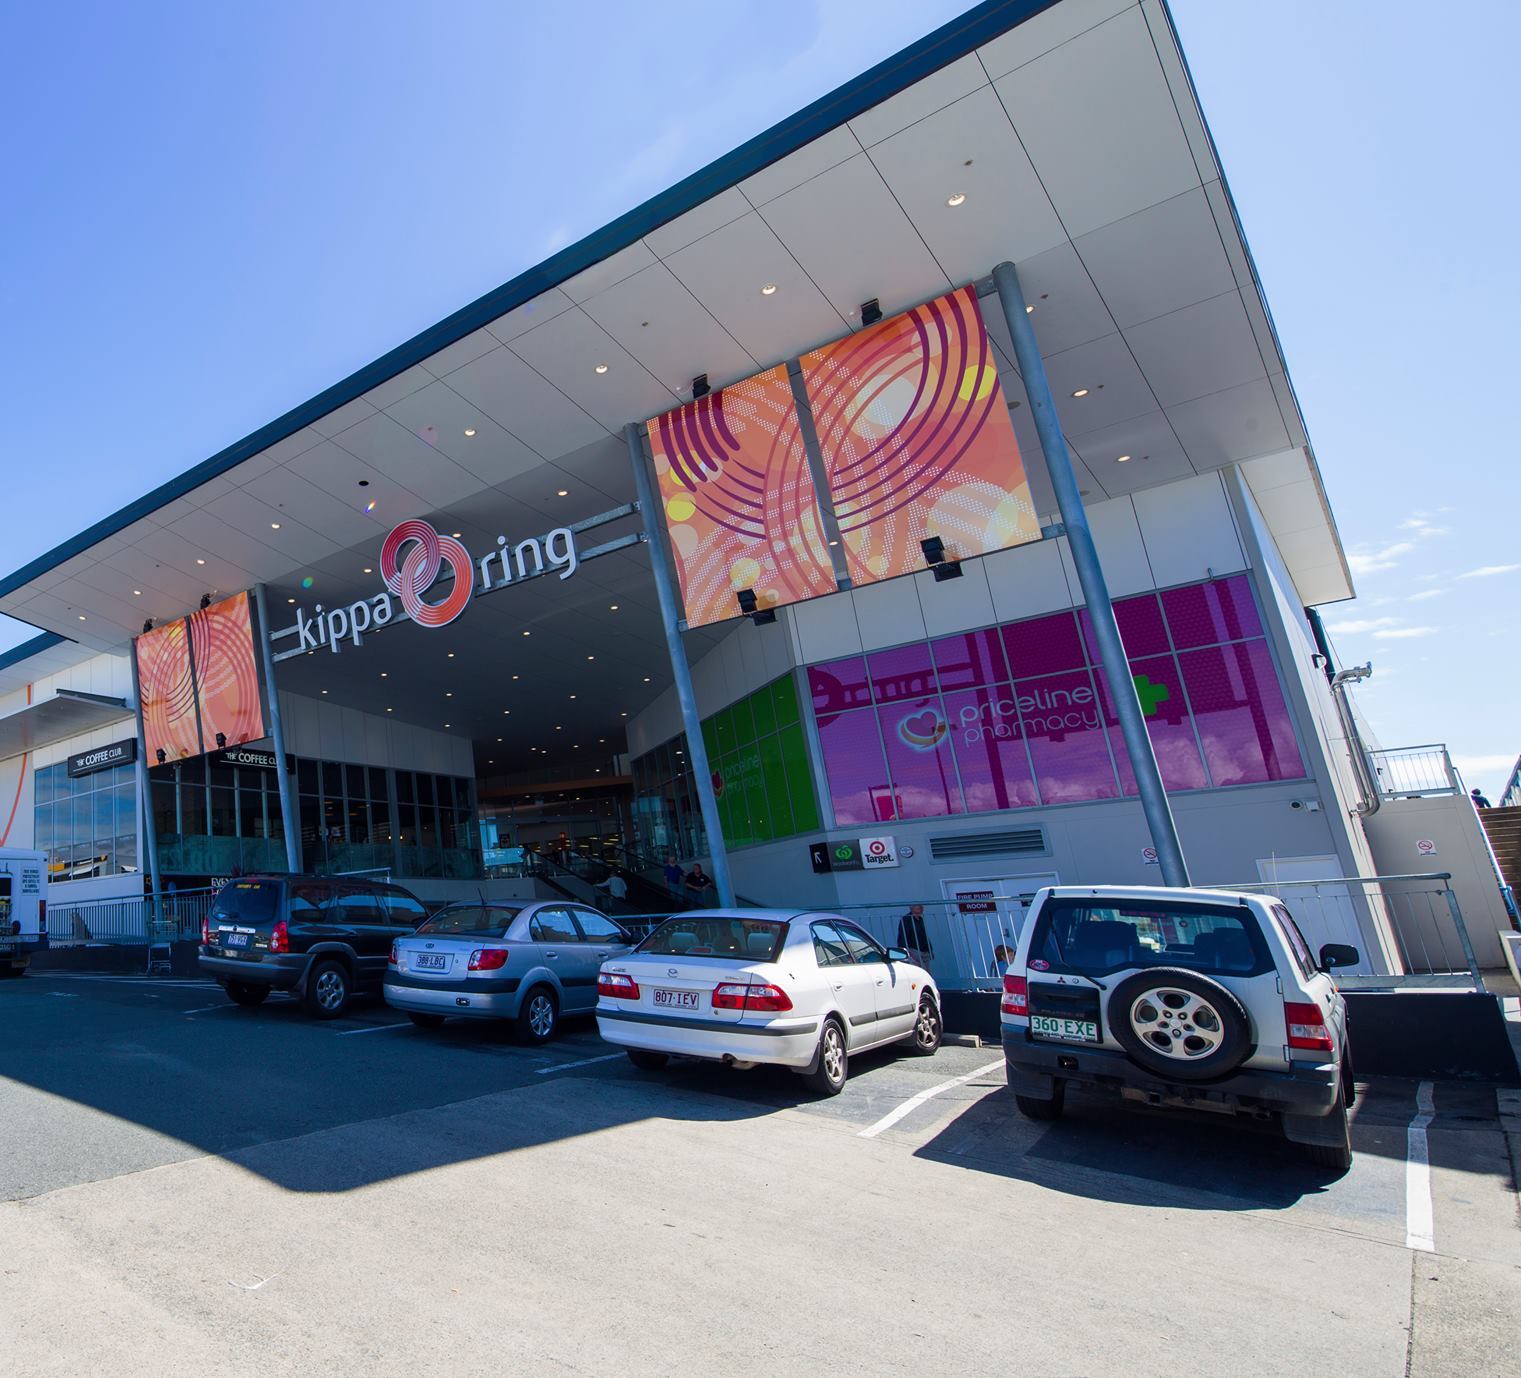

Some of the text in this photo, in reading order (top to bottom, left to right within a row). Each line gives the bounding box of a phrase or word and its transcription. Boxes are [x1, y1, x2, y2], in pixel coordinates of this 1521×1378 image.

[296, 527, 576, 652] kippa ring
[960, 686, 1094, 728] priceline
[963, 709, 1100, 748] pharmacy
[85, 750, 109, 765] COFFEE
[108, 747, 123, 758] CLUB
[225, 752, 277, 765] THE COFFEE CL
